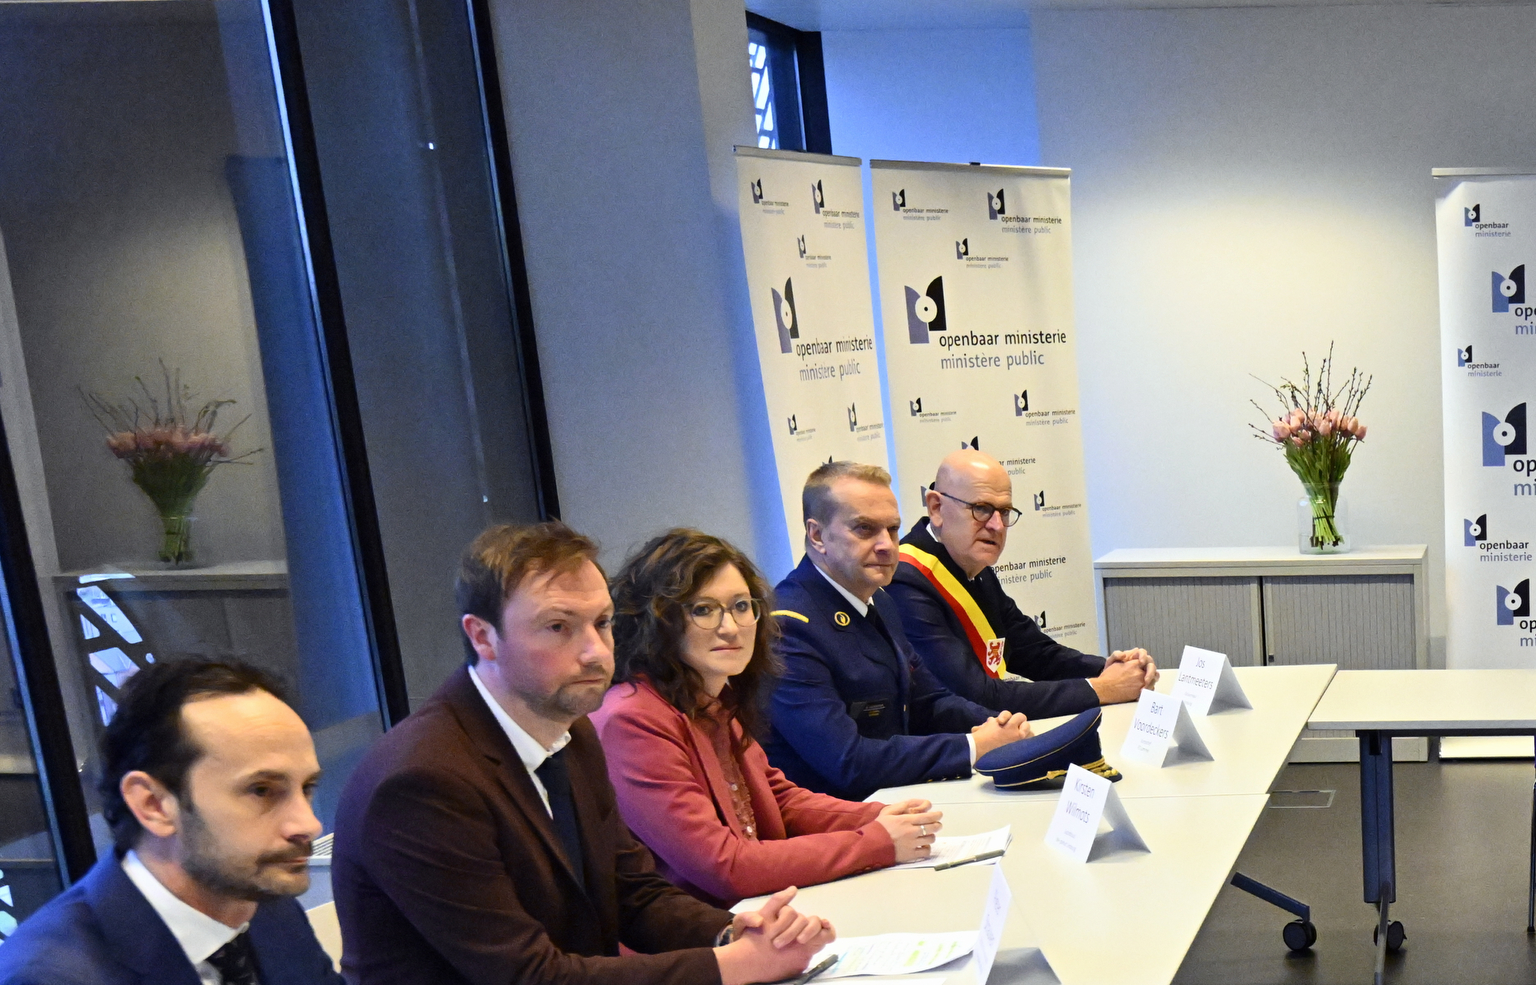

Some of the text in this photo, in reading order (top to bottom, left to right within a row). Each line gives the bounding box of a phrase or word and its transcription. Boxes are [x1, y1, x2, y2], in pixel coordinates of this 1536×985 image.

[1001, 215, 1062, 224] openbaar ministerie
[1034, 226, 1051, 235] public
[1475, 222, 1509, 230] openbaar
[1475, 230, 1511, 238] ministerie
[939, 329, 1066, 351] openbaar ministerie
[796, 334, 873, 361] openbaar ministerie
[940, 350, 1045, 370] ministère public
[799, 358, 861, 381] ministère public
[1468, 362, 1500, 370] openbaar
[1025, 410, 1050, 418] openbaar
[1052, 418, 1069, 426] public
[1006, 457, 1036, 466] ministerie
[1479, 540, 1530, 552] openbaar
[1029, 556, 1066, 568] ministerie
[1480, 552, 1533, 562] ministerie
[1030, 569, 1053, 583] public
[1196, 657, 1206, 668] Jos
[1150, 702, 1164, 716] Bart
